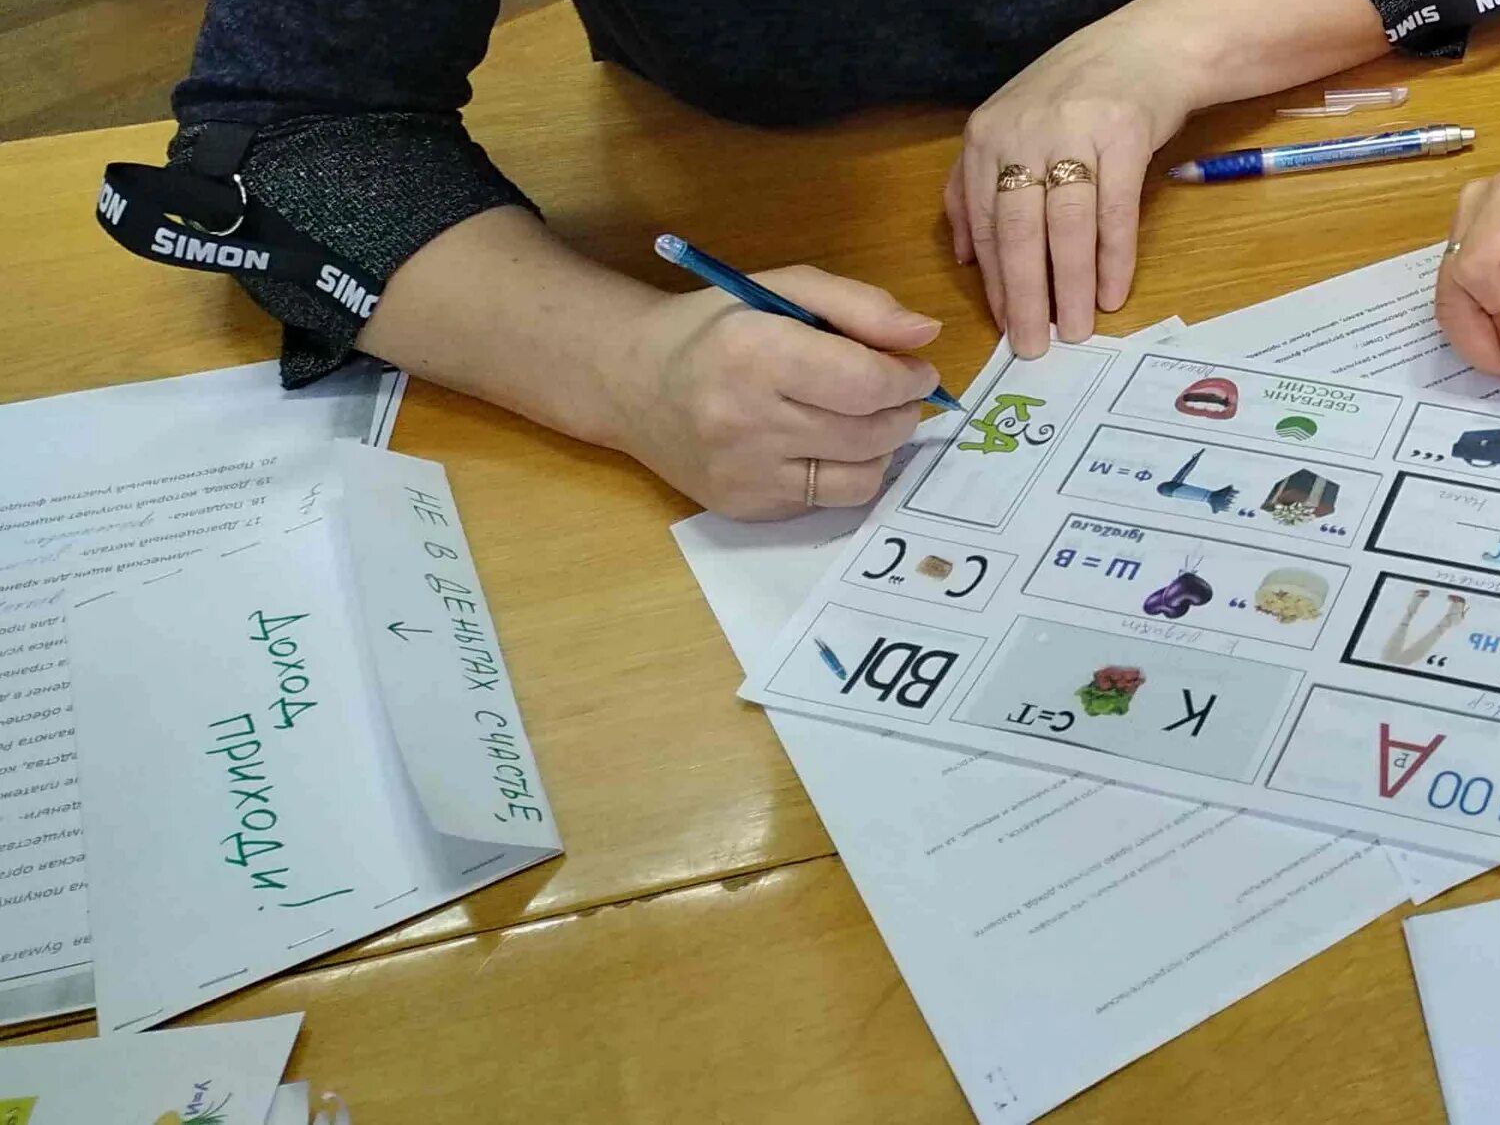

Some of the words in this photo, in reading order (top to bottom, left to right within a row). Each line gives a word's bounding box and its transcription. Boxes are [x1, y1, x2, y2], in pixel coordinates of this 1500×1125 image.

[1386, 4, 1441, 44] SIMO
[97, 182, 128, 225] ON
[151, 227, 270, 271] SIMON
[316, 263, 379, 319] SIMO
[1263, 391, 1360, 414] СБЕРБАНК
[1277, 380, 1355, 402] РОССИИ
[116, 459, 254, 495] Профессиональный
[404, 485, 449, 527] НЕ
[139, 519, 237, 548] Драгоценный
[424, 541, 458, 561] В
[1054, 550, 1074, 568] В
[1106, 559, 1141, 581] Ш
[424, 573, 500, 691] ДЕНЬГАХ
[1163, 689, 1216, 737] К
[475, 710, 543, 823] СЧАСТЬЕ,
[1379, 723, 1447, 799] А
[38, 852, 85, 871] еская
